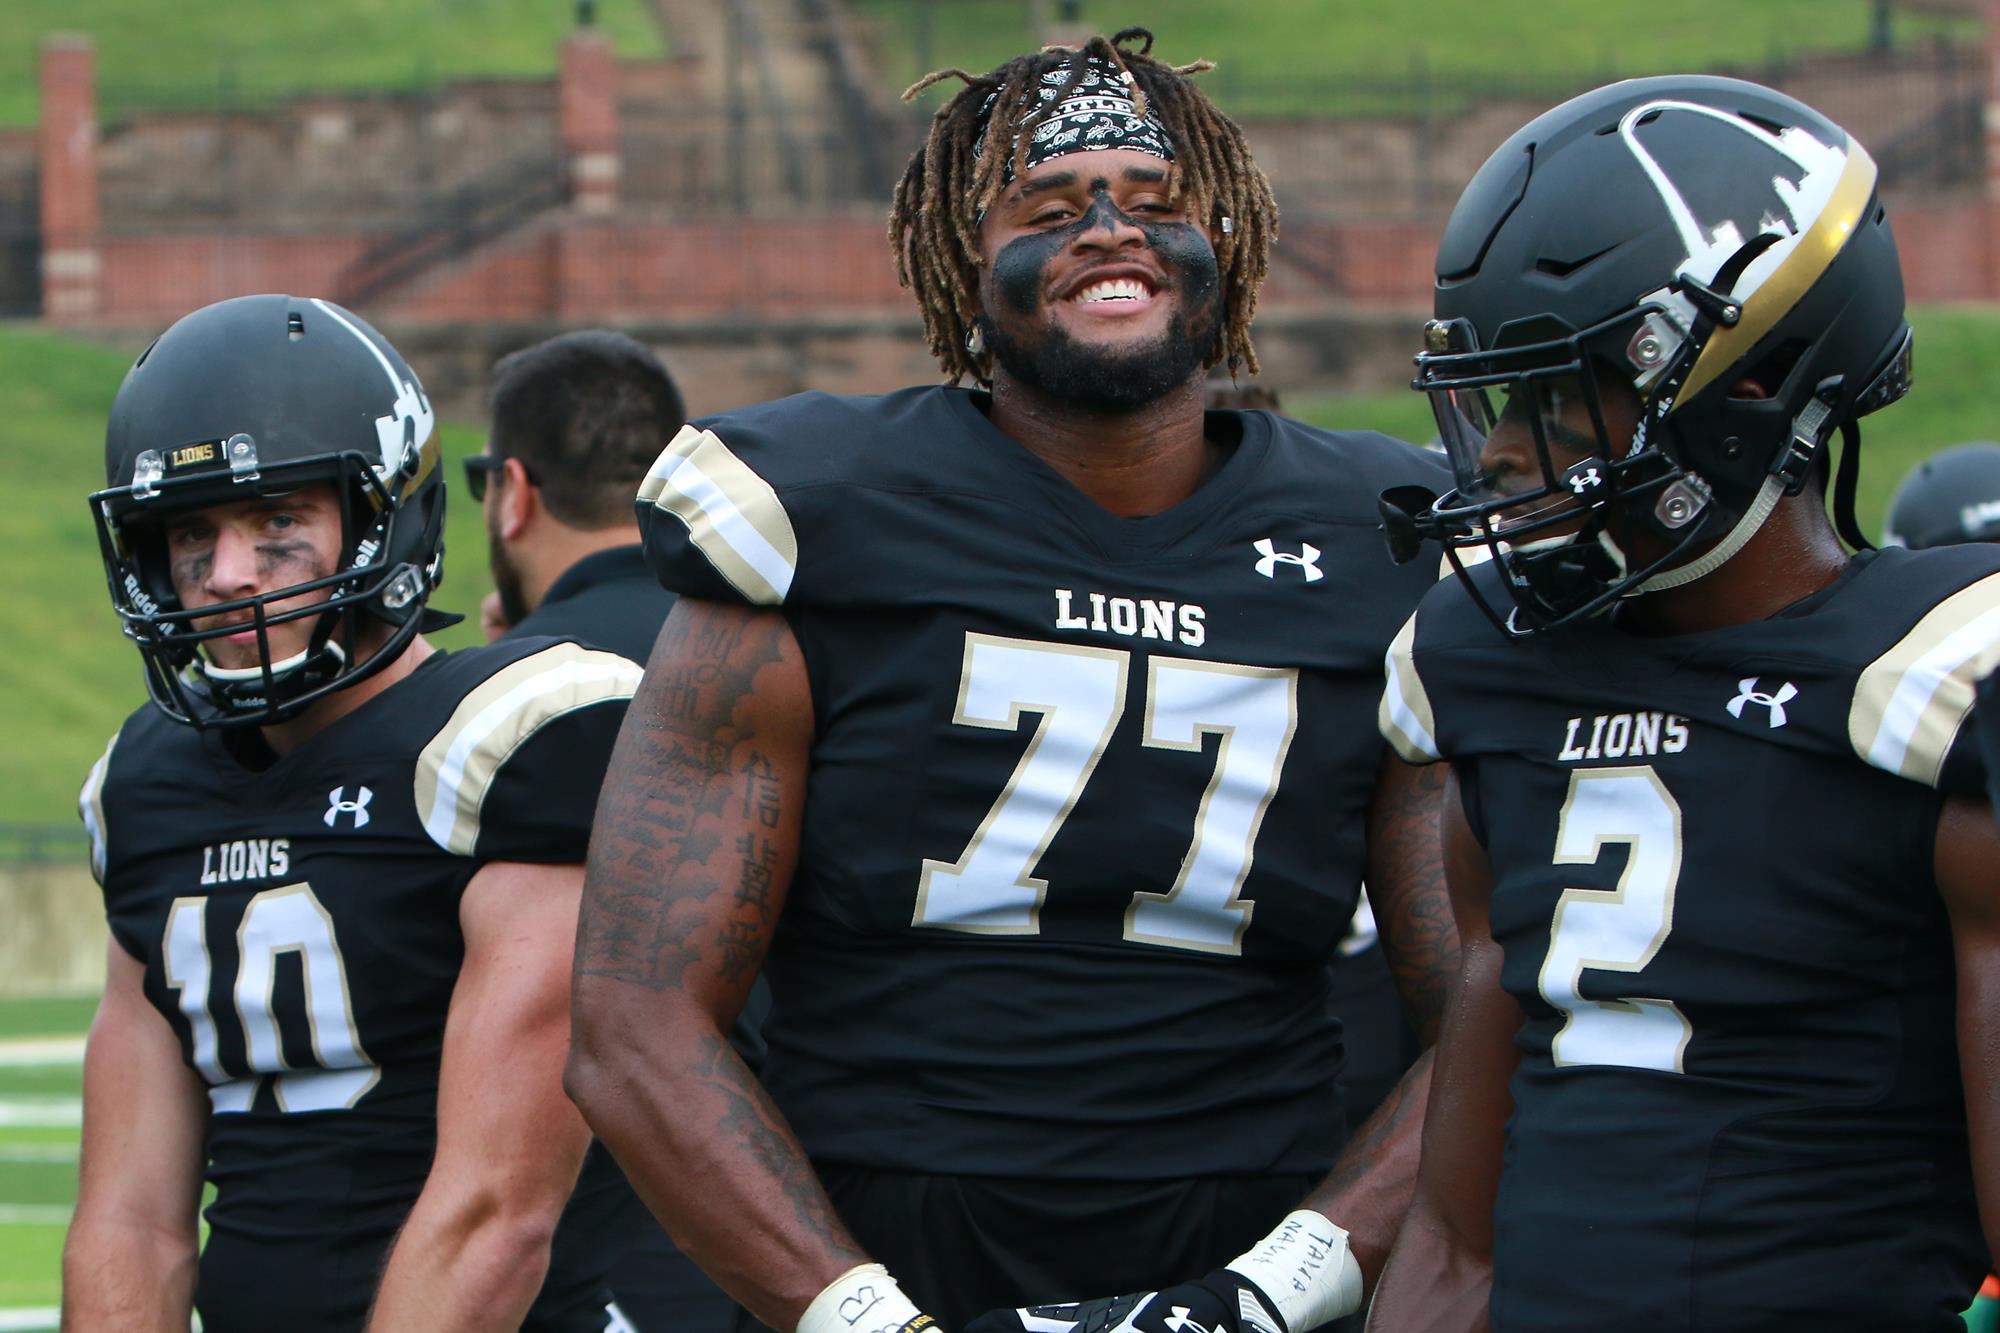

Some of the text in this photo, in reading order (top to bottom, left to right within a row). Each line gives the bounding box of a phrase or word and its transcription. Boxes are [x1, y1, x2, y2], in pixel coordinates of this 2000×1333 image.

[1050, 99, 1133, 117] TTLE
[172, 444, 214, 466] LIONS
[124, 573, 176, 636] Riddll
[1055, 588, 1206, 647] LIONS
[1558, 711, 1691, 761] LIONS
[911, 631, 1299, 956] 77
[200, 839, 290, 885] LIONS
[1538, 765, 1693, 1075] 2
[162, 882, 382, 1115] 10
